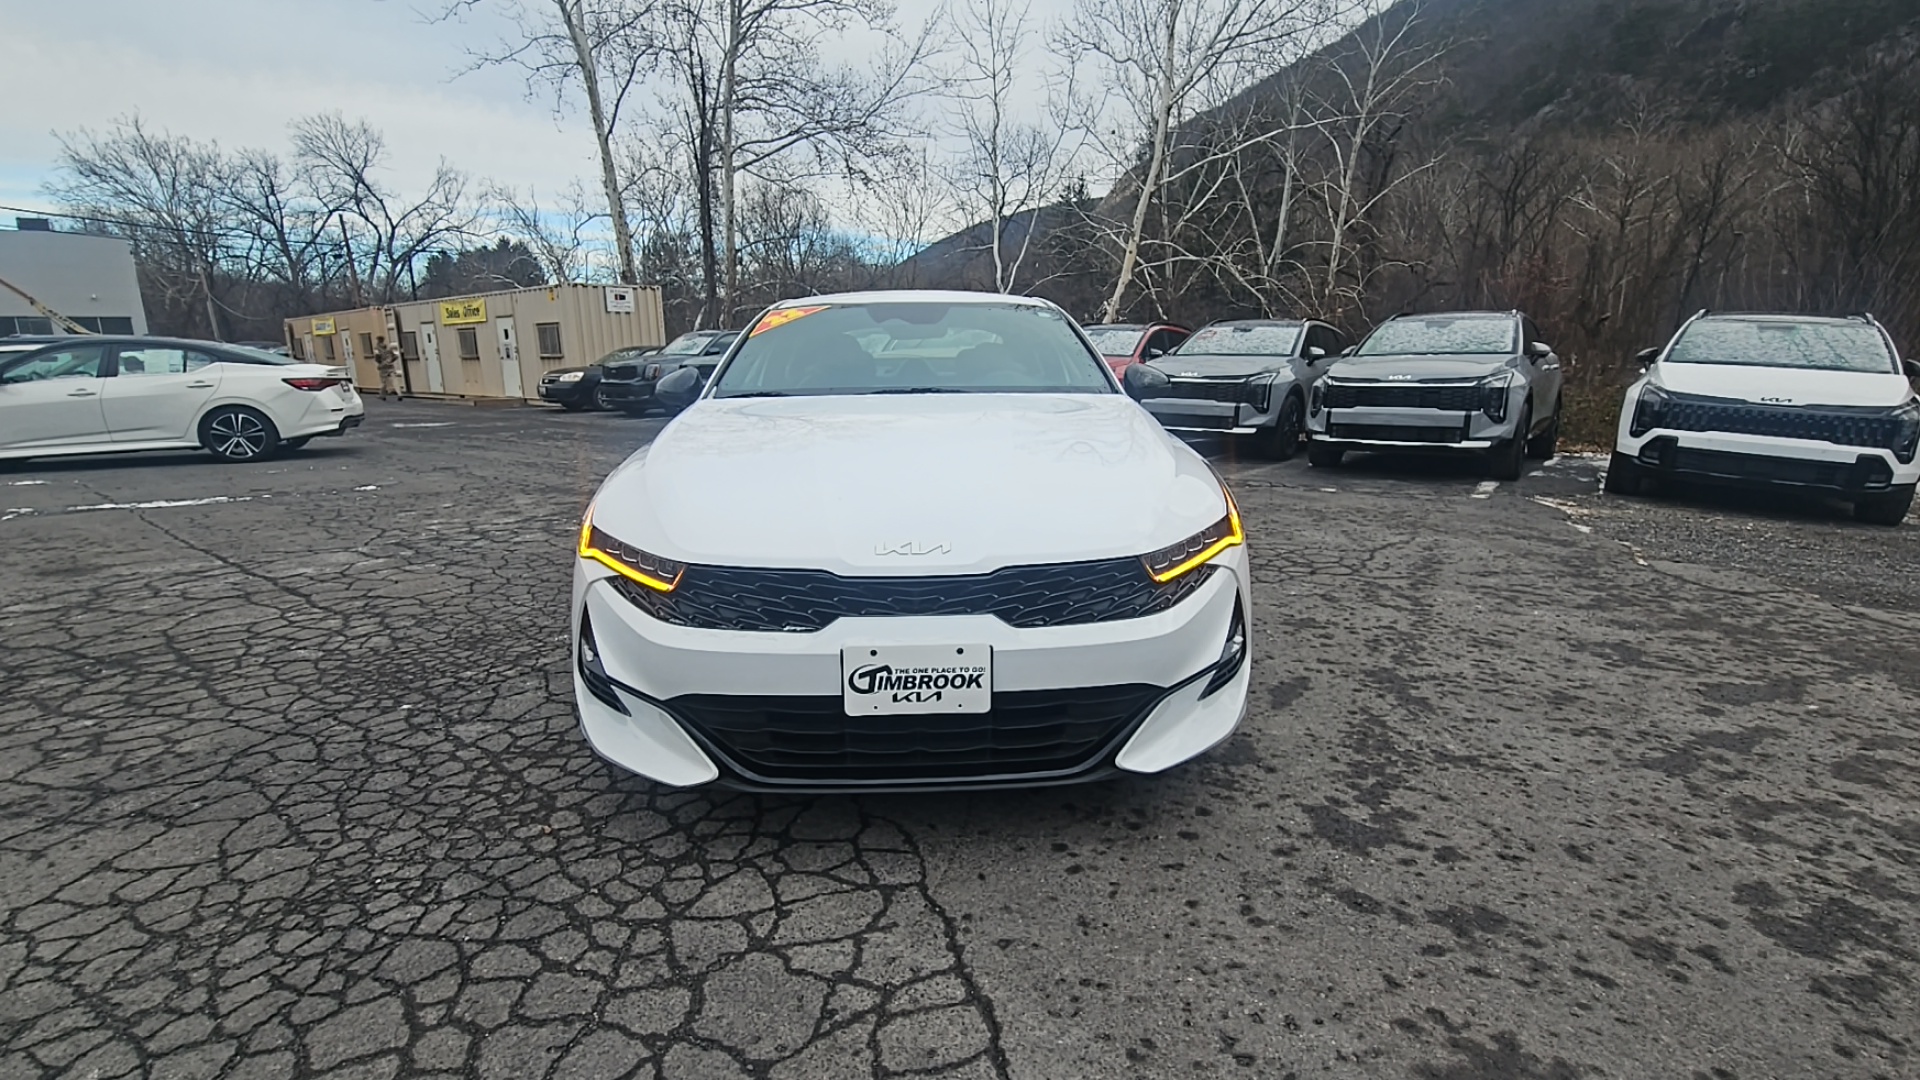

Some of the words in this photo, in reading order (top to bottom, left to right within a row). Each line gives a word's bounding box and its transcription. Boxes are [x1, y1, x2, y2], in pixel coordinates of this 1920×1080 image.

[445, 306, 461, 319] Sales
[463, 304, 480, 318] Office
[874, 541, 952, 556] KIA
[850, 664, 985, 694] TIMBROOK
[892, 691, 942, 704] KIA
